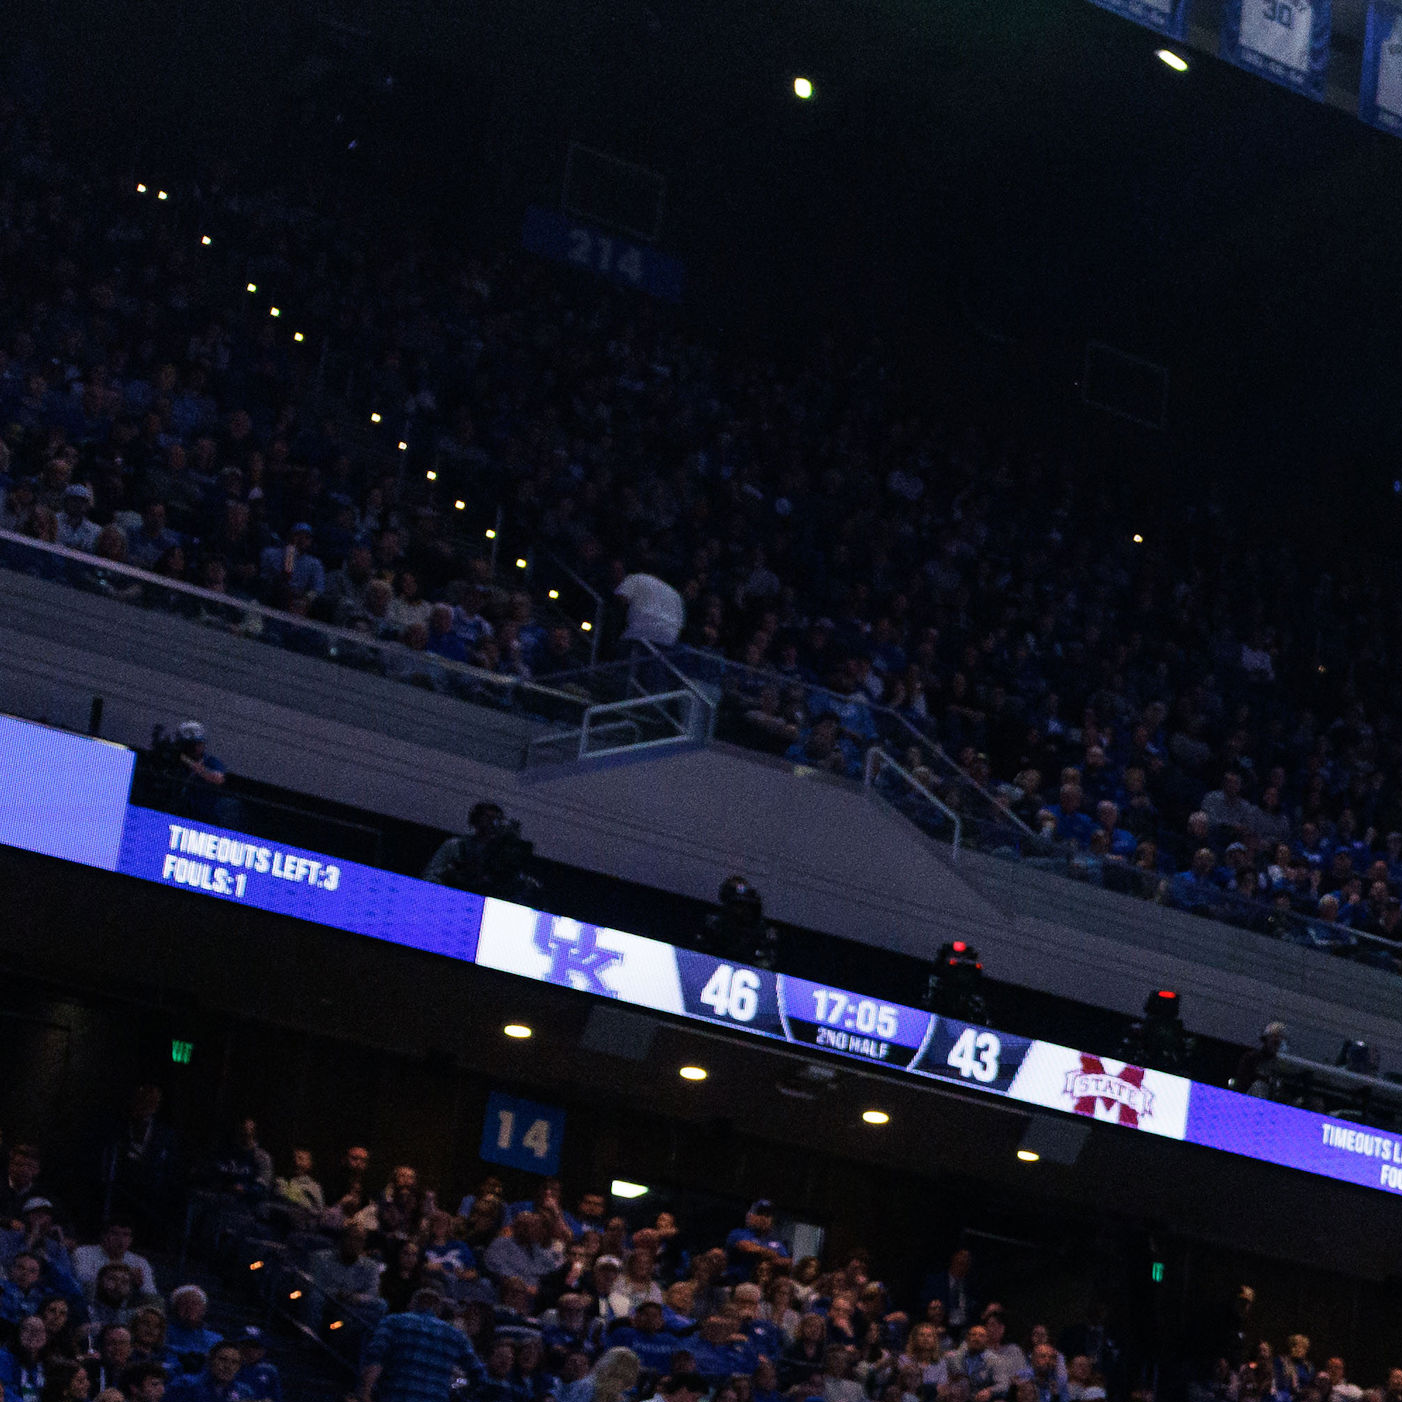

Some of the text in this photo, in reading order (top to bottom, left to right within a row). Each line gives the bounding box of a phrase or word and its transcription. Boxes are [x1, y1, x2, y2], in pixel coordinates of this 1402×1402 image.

[162, 854, 247, 898] FOULS:1
[168, 824, 340, 891] TIMEOUTS LEFT:3
[700, 963, 760, 1022] 46
[812, 988, 899, 1039] 17:05
[815, 1027, 890, 1060] 2ND HALF
[947, 1027, 1001, 1084] 43
[1077, 1076, 1138, 1105] STATE
[497, 1110, 550, 1158] 14
[1322, 1123, 1393, 1160] TIMEOUTS
